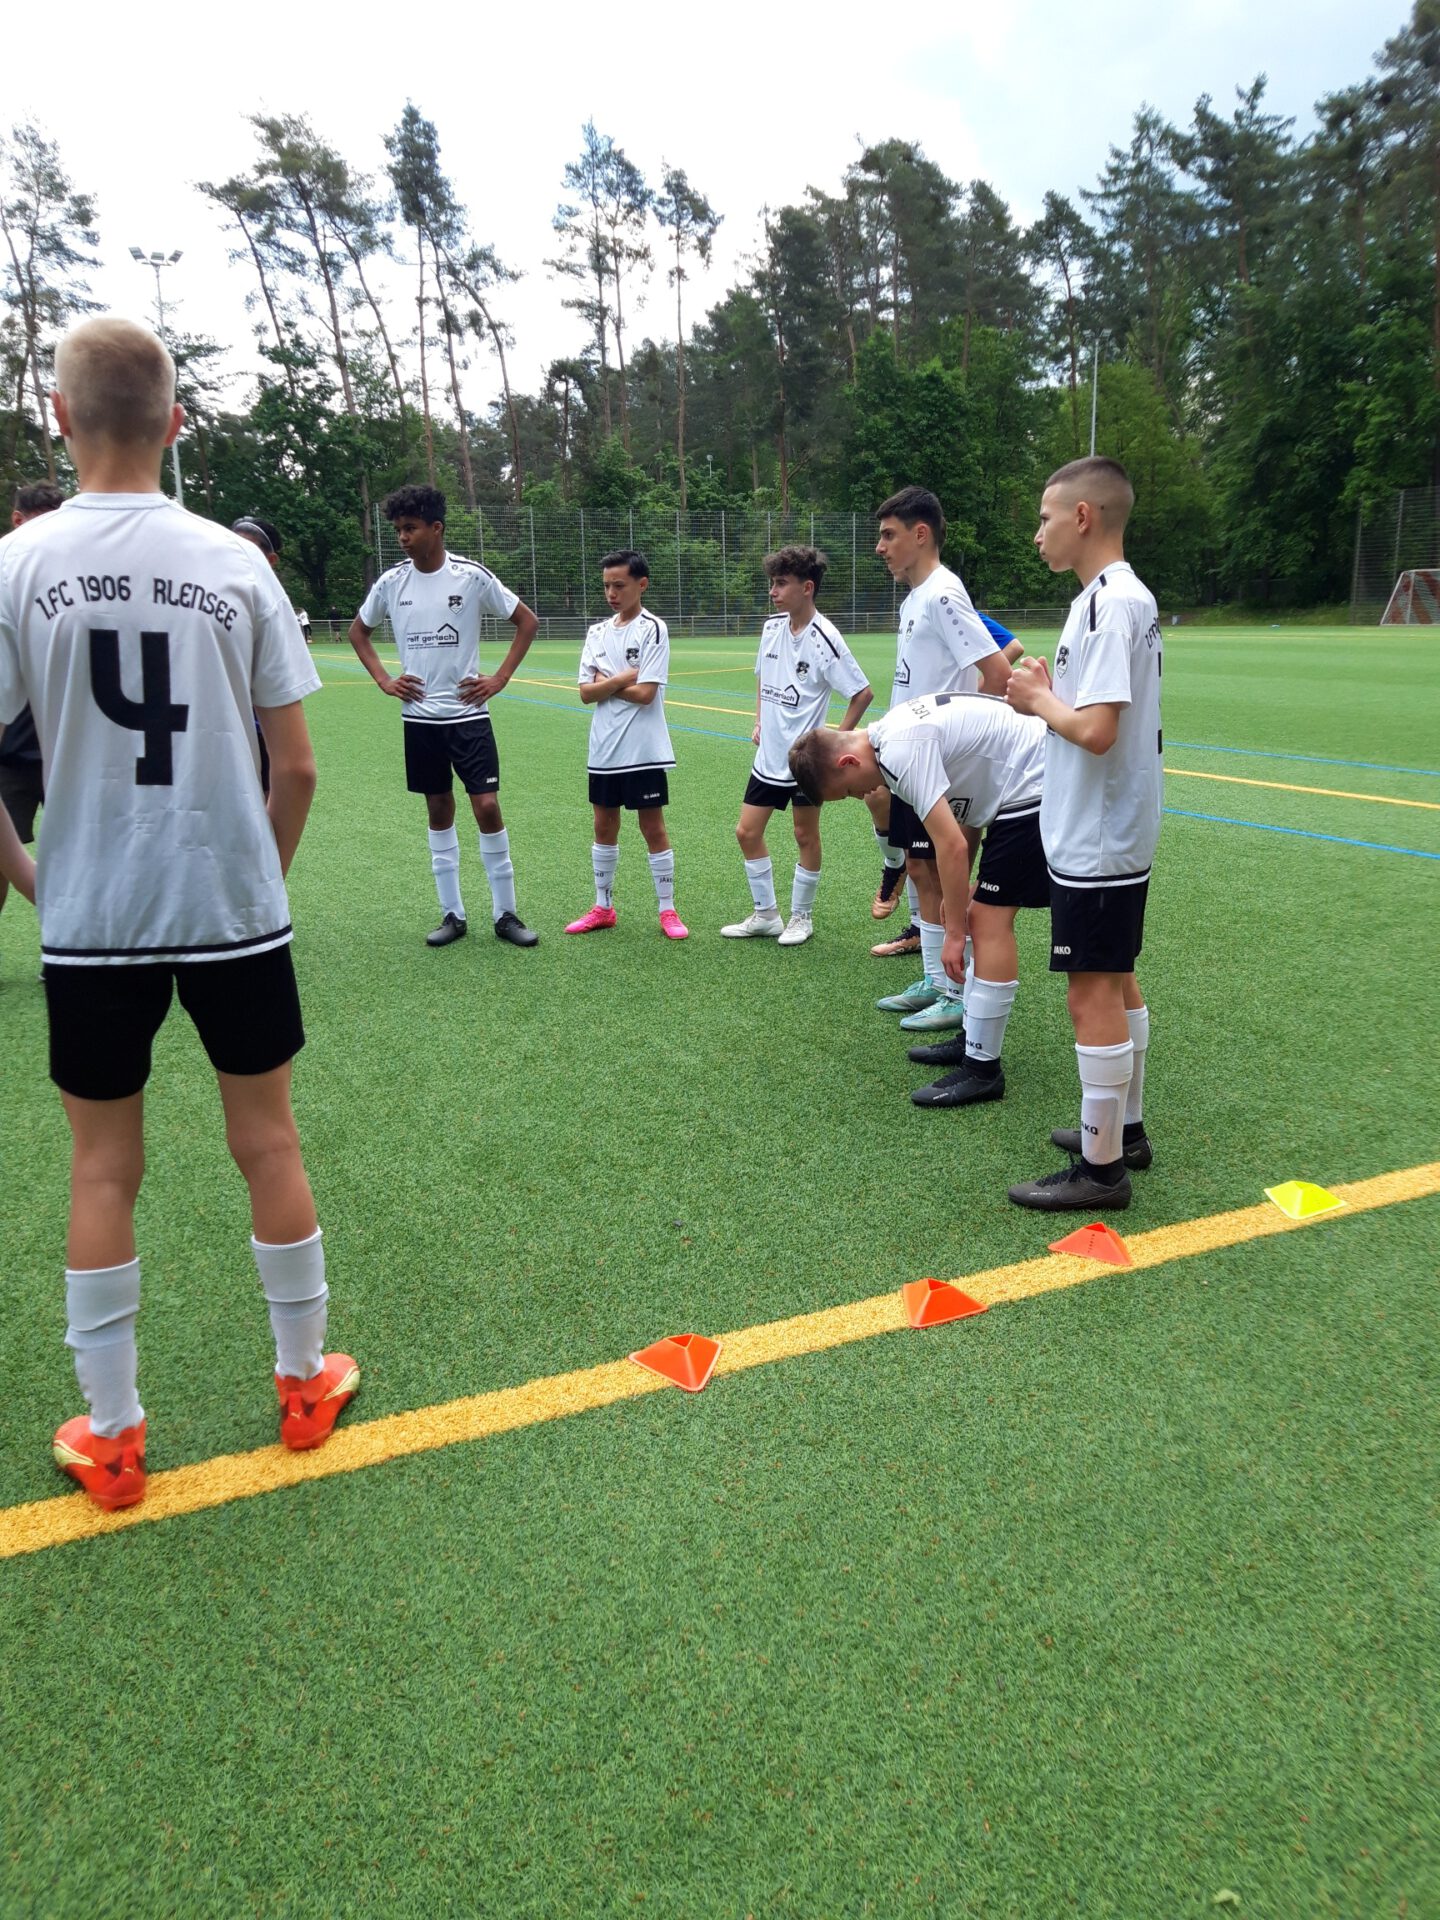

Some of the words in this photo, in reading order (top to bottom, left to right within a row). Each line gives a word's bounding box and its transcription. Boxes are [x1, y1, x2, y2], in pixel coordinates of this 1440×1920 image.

[35, 580, 75, 620] 1.FC
[77, 575, 131, 602] 1906
[88, 628, 189, 785] 4
[911, 840, 929, 849] JAKO
[980, 880, 1000, 893] JAKO
